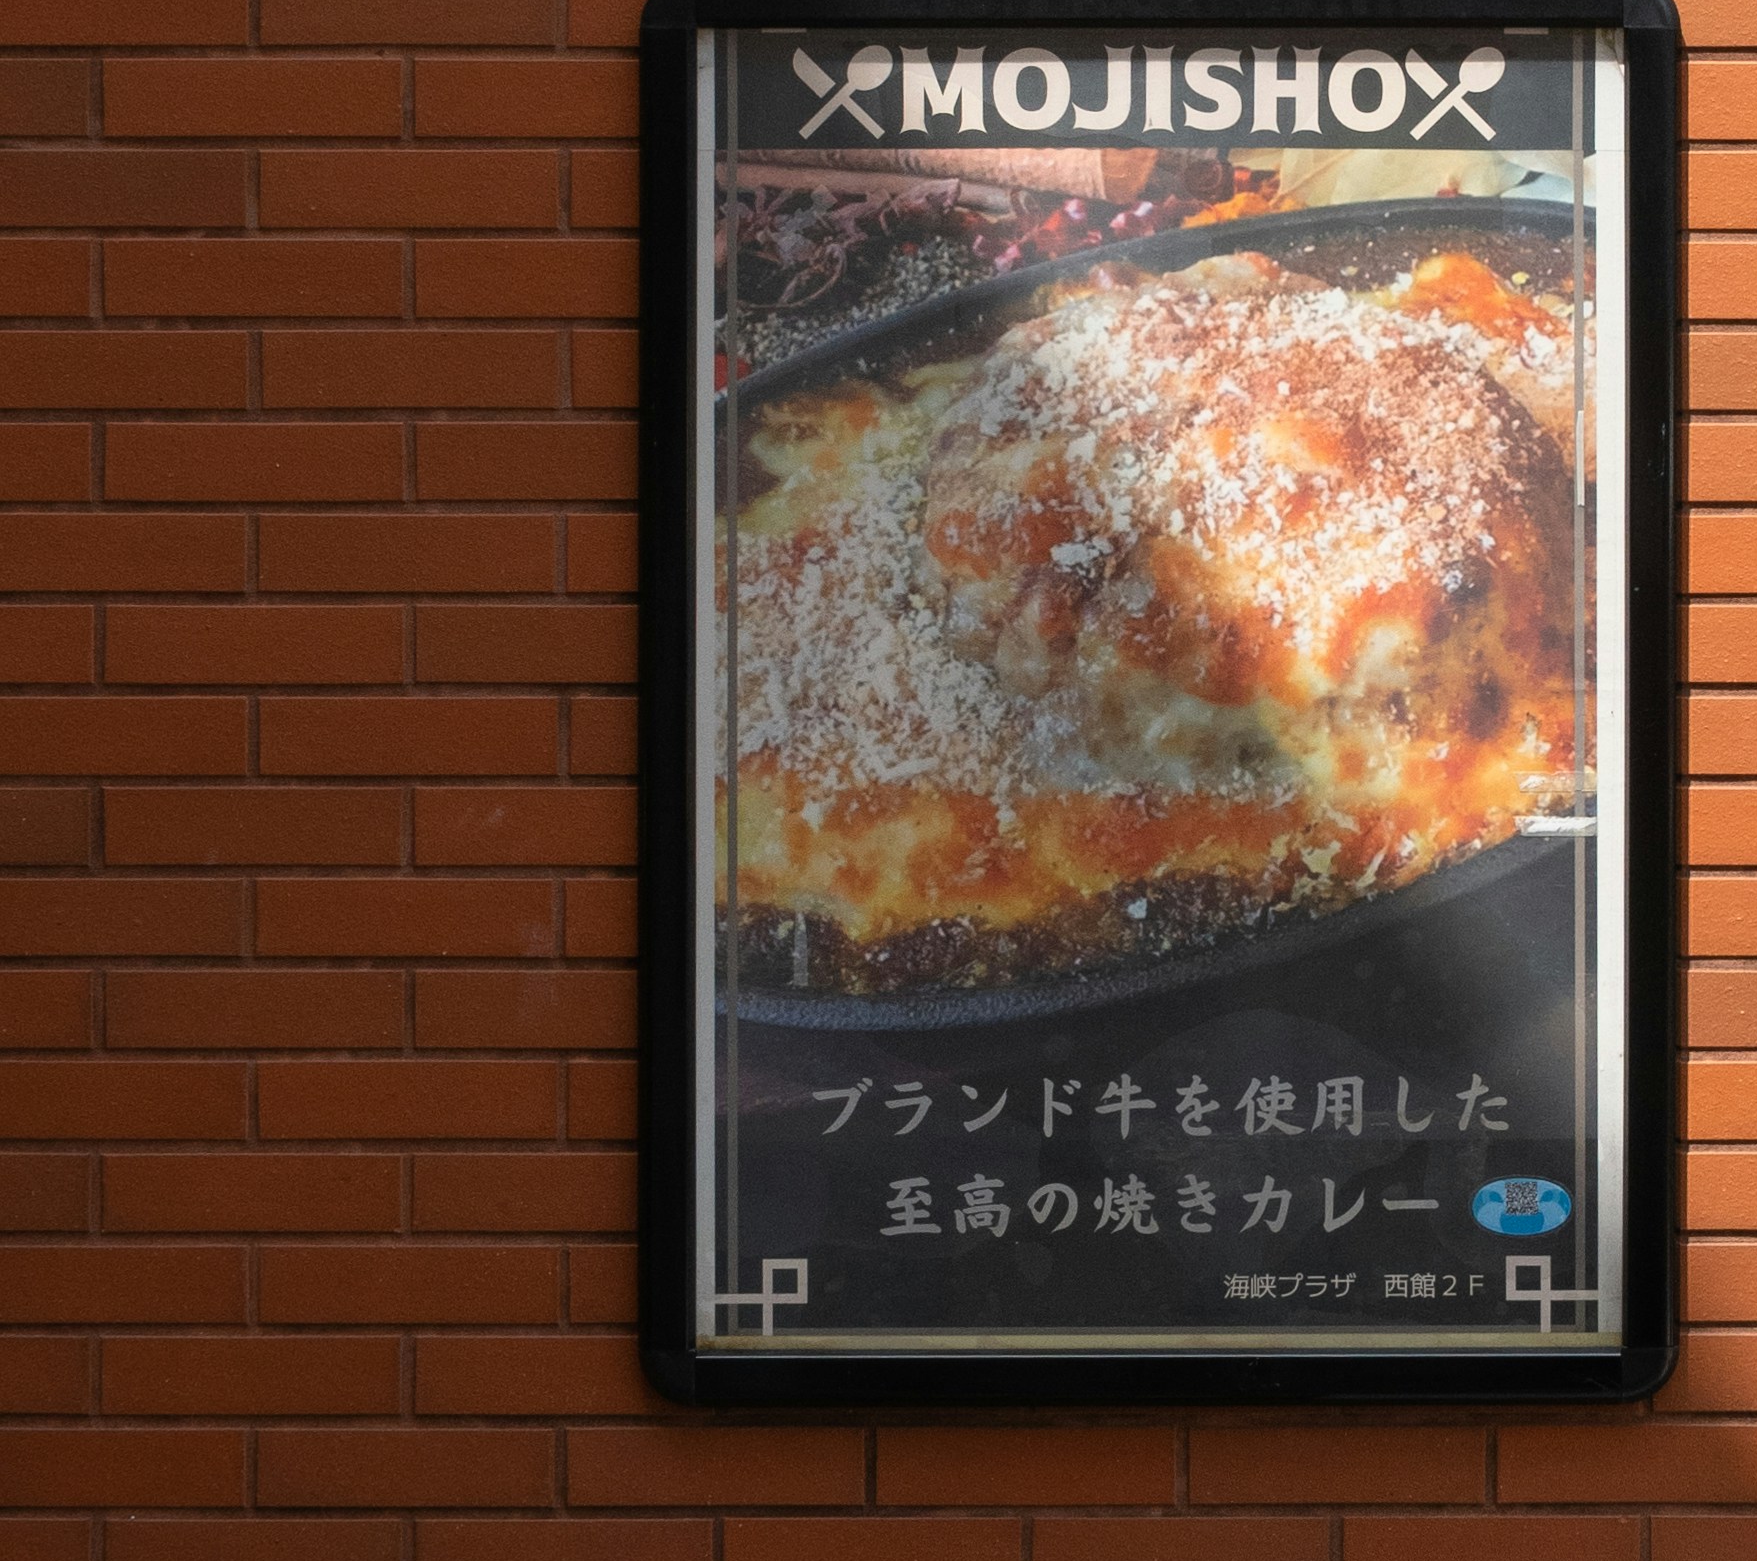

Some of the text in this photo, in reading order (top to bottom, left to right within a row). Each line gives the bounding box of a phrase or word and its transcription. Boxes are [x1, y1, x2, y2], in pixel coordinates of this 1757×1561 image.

[900, 45, 1406, 134] MOJISHO
[812, 1072, 1510, 1140] ブランド牛を使用した
[880, 1174, 1439, 1237] 至高の焼きカレー
[1224, 1273, 1356, 1299] 海峡プラザ
